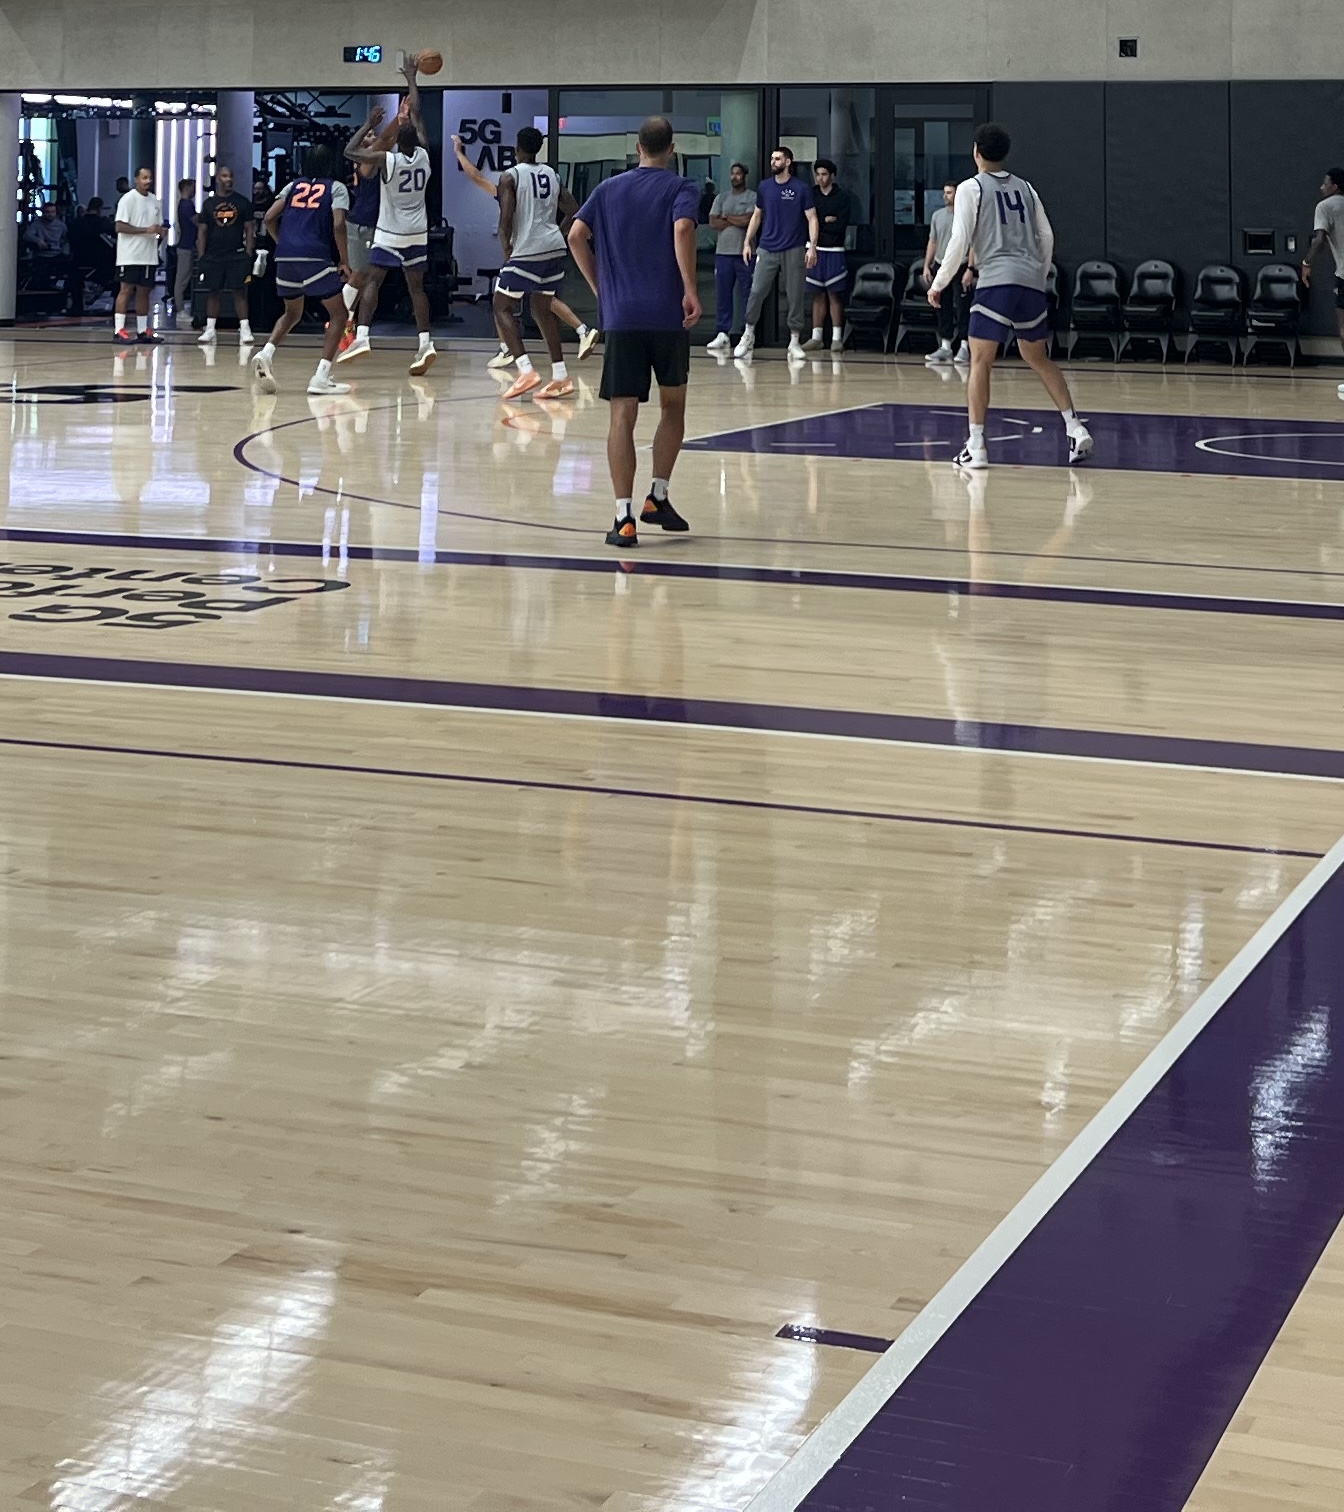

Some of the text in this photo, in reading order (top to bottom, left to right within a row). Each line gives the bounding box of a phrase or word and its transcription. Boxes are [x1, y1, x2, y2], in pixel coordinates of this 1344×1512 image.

[355, 45, 381, 62] 1:46
[459, 118, 502, 144] 5G
[398, 169, 426, 193] 20
[530, 172, 551, 199] 19
[290, 182, 326, 209] 22
[994, 189, 1026, 225] 14
[7, 604, 222, 630] 5G
